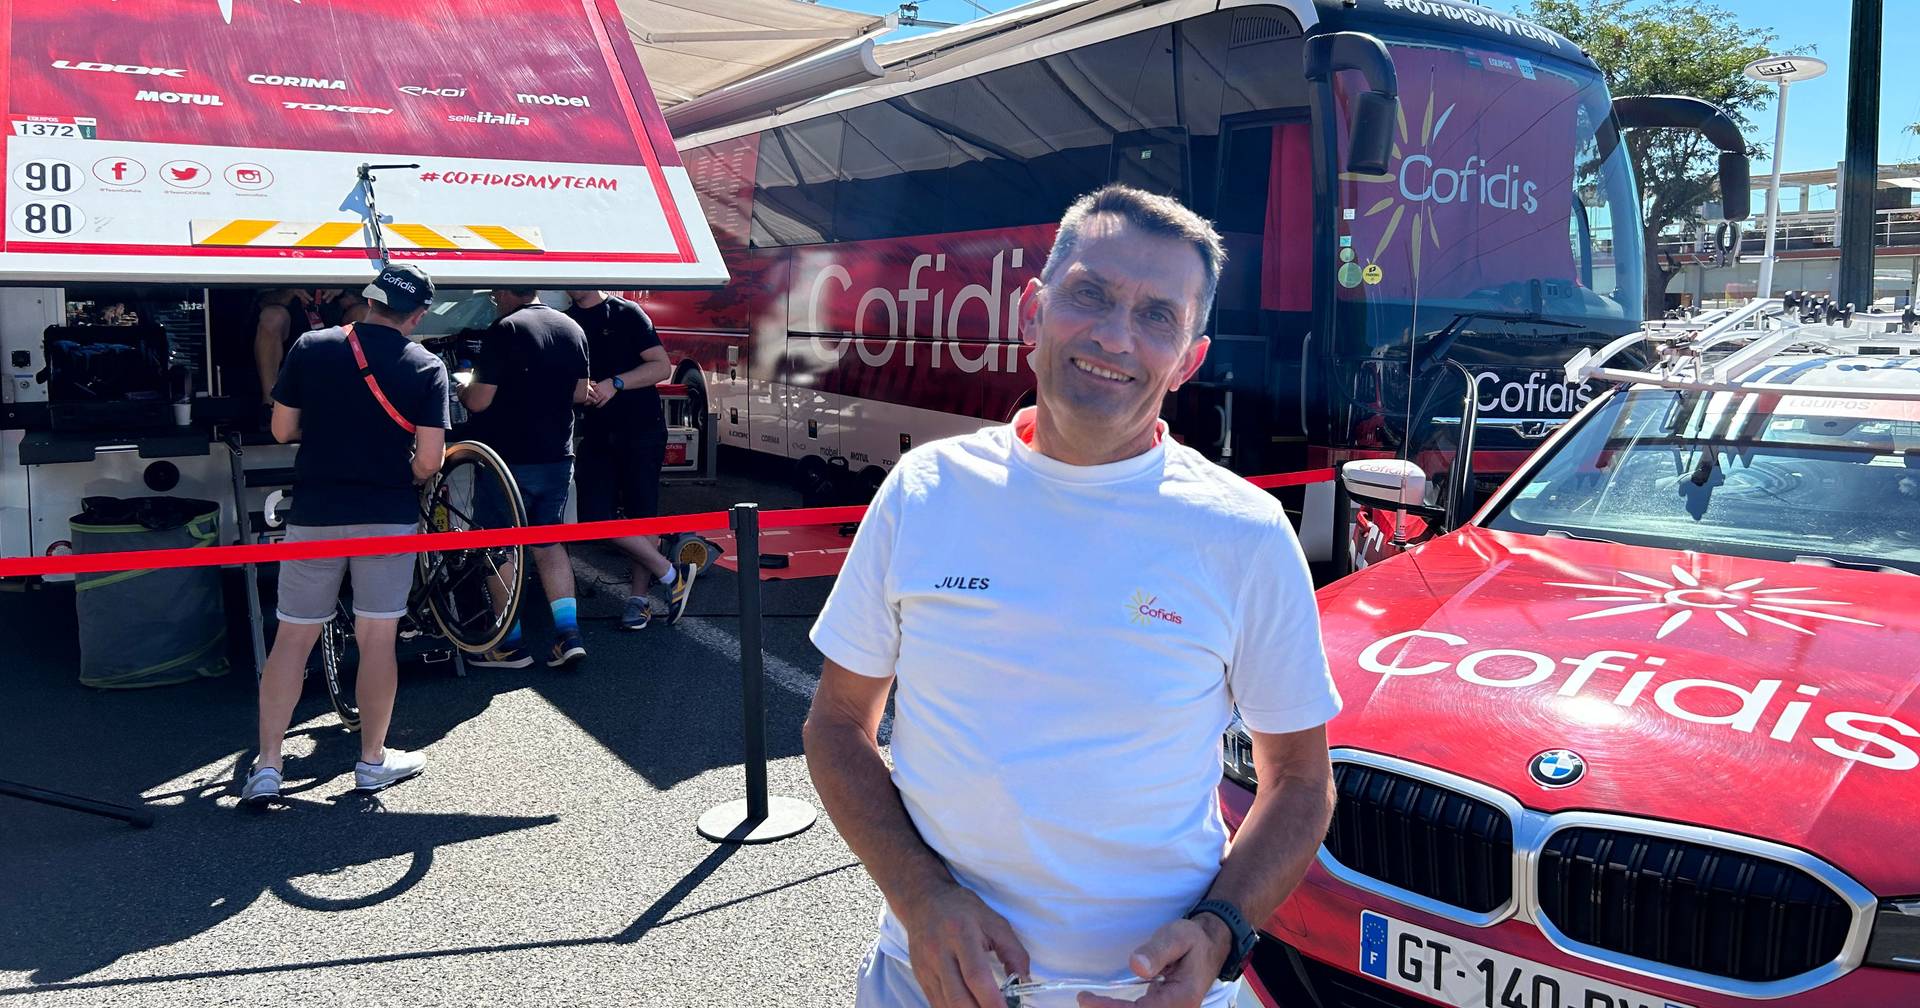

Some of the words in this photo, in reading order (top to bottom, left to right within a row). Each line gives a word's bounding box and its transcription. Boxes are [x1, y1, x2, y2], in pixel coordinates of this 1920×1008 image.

[1384, 0, 1560, 49] #COFIDISMYTEAM
[51, 59, 187, 78] LOOK
[247, 74, 347, 91] CORIMA
[135, 90, 224, 107] MOTUL
[281, 101, 394, 116] TOKEN
[516, 92, 591, 108] mobel
[20, 122, 75, 138] 1372
[25, 162, 71, 193] 90
[418, 171, 618, 192] #COFIDISMYTEAM
[1399, 154, 1538, 215] Cofidis
[25, 203, 72, 234] 80
[382, 272, 417, 294] Cofidis
[1475, 371, 1593, 413] Cofidis
[934, 577, 990, 590] JULES
[1139, 604, 1182, 624] Cofidis
[1358, 629, 1920, 771] Cofidis
[1369, 951, 1379, 965] F
